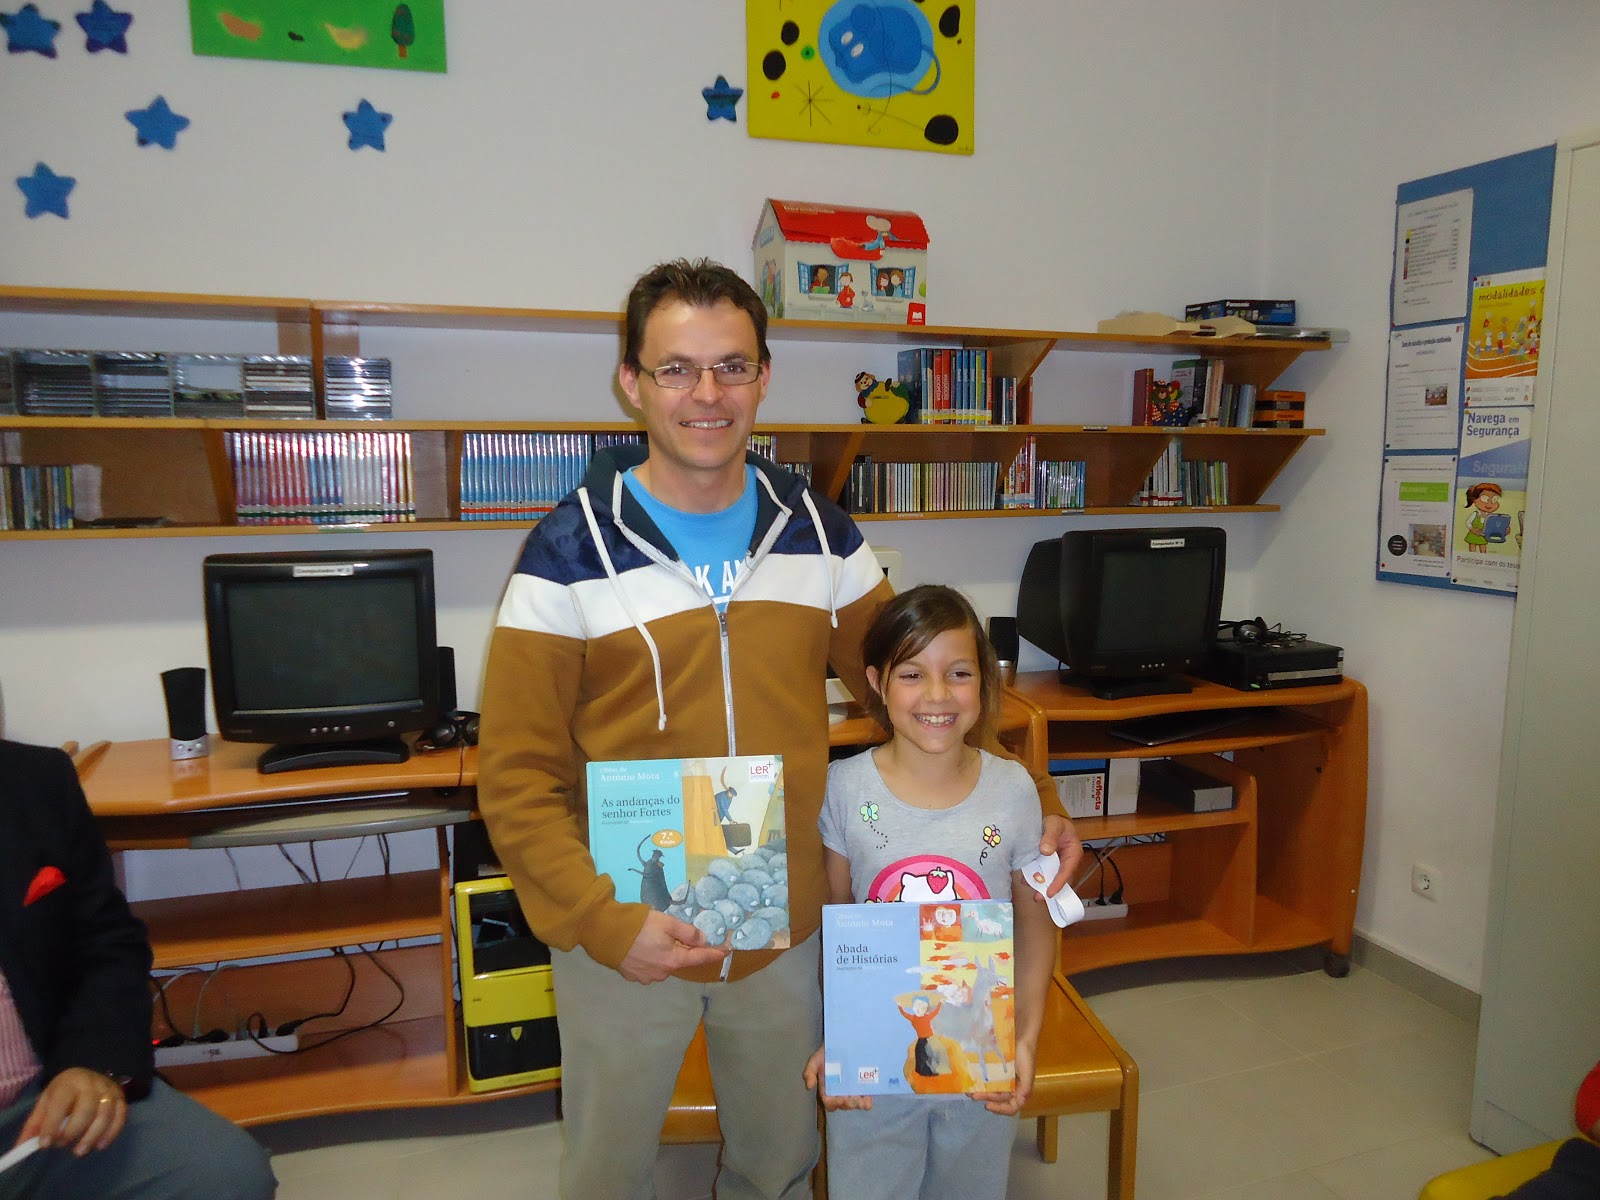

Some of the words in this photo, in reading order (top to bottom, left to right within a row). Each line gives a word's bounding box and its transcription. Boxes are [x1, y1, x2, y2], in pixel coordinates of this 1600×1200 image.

[1478, 286, 1537, 301] modalidades
[1467, 413, 1506, 425] Navega
[1466, 425, 1520, 439] Segurança
[636, 772, 661, 781] Mota
[601, 798, 614, 808] As
[616, 796, 665, 808] andanças
[667, 794, 681, 805] do
[602, 808, 638, 819] senhor
[639, 807, 672, 818] Fortes
[871, 919, 894, 928] Mota
[835, 943, 869, 954] Abada
[836, 955, 849, 965] de
[852, 953, 898, 964] Histórias
